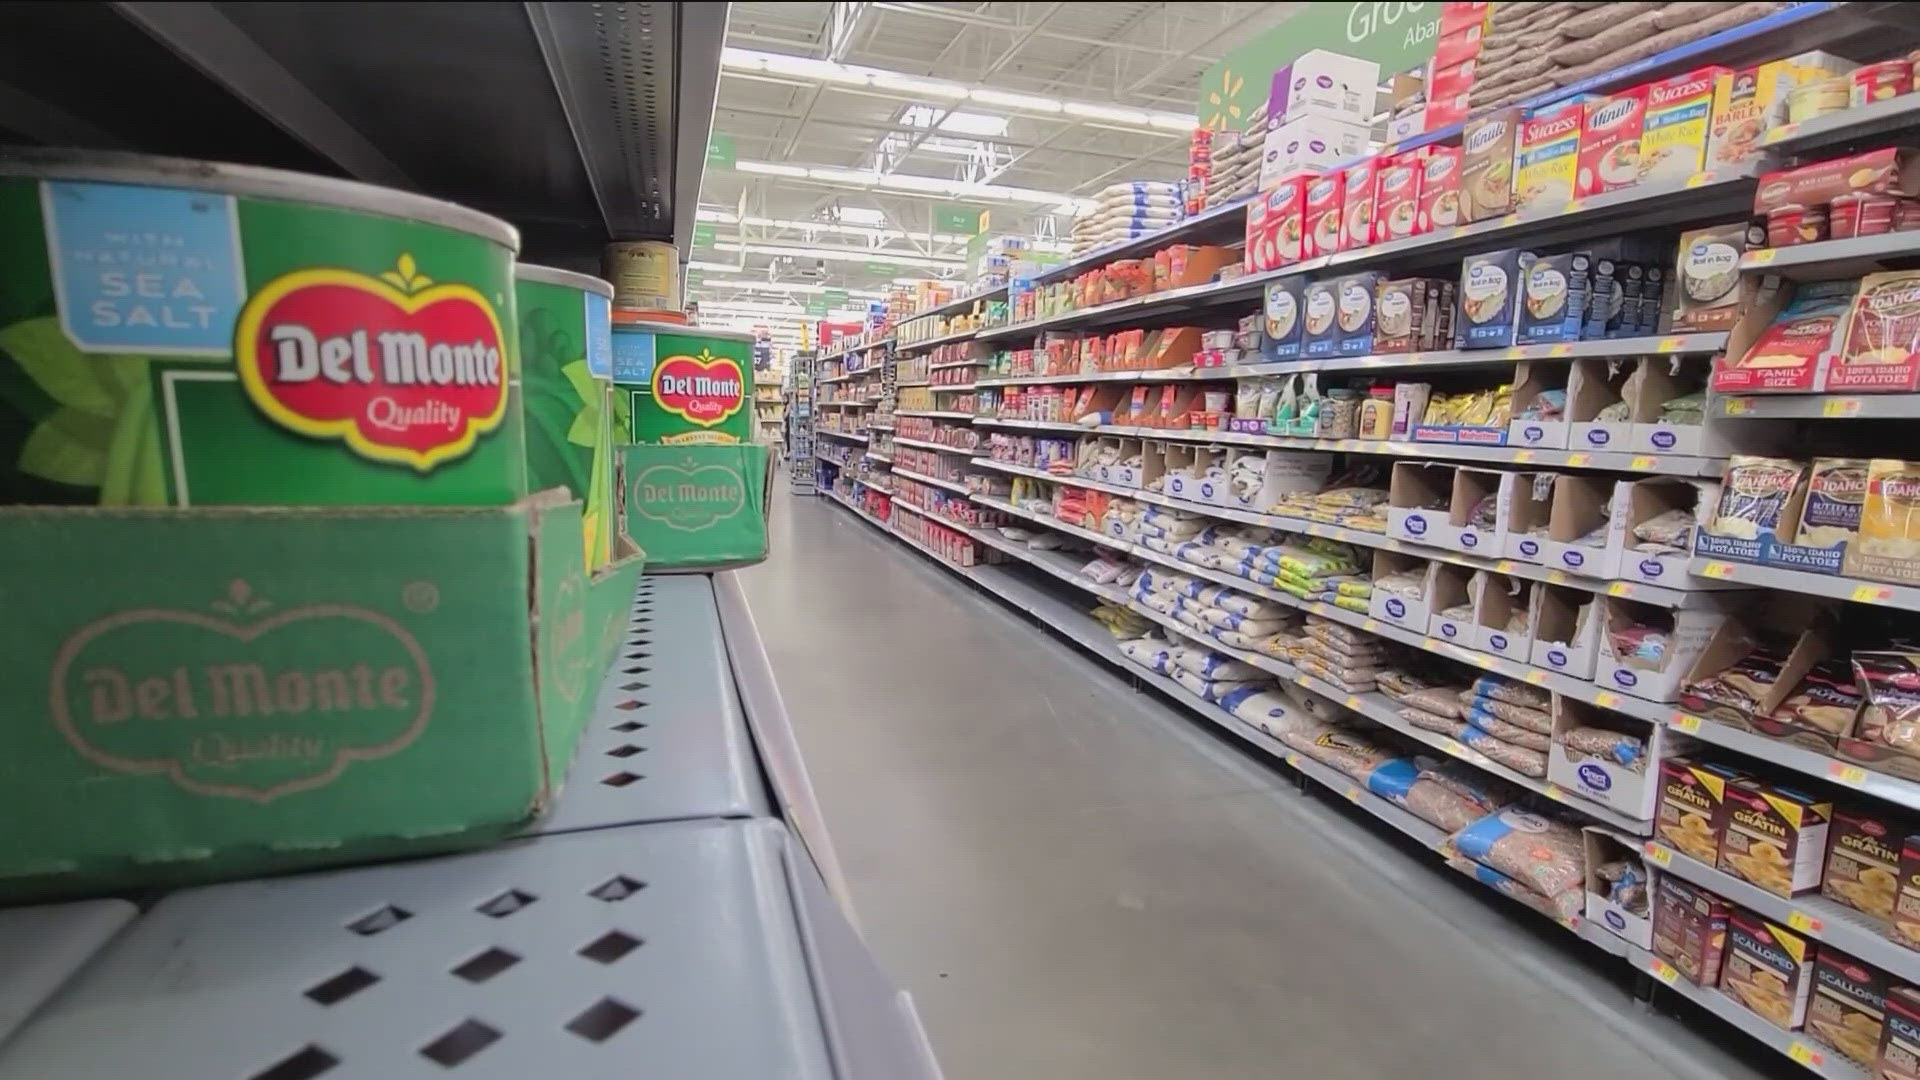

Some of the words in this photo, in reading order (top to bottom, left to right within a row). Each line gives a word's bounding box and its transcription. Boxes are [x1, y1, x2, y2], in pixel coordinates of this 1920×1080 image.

[1648, 80, 1707, 105] Success
[1717, 105, 1765, 125] BARLEY
[1526, 116, 1577, 143] Success
[101, 272, 204, 300] SEA
[91, 301, 217, 330] SALT
[270, 325, 373, 384] Del
[378, 331, 500, 388] Monte
[617, 357, 645, 367] SEA
[614, 367, 647, 377] SALT
[1757, 369, 1808, 379] FAMILY
[1844, 374, 1910, 384] POTATOES
[1875, 366, 1911, 375] IDAHO
[662, 374, 693, 396] Del
[695, 375, 740, 397] Monte
[1763, 378, 1797, 387] SIZE
[366, 397, 461, 432] Quality
[689, 400, 723, 414] Quality
[643, 484, 674, 503] Del
[678, 483, 737, 503] Monte
[1709, 544, 1761, 557] POTATOES
[1782, 552, 1839, 567] POTATOES
[1808, 548, 1840, 558] IDAHO
[85, 663, 198, 724] Del
[209, 662, 411, 717] Monte
[1667, 785, 1710, 809] GRATIN
[1734, 811, 1786, 837] GRATIN
[1841, 835, 1899, 863] GRATIN
[1732, 933, 1795, 971] SCALLOPED
